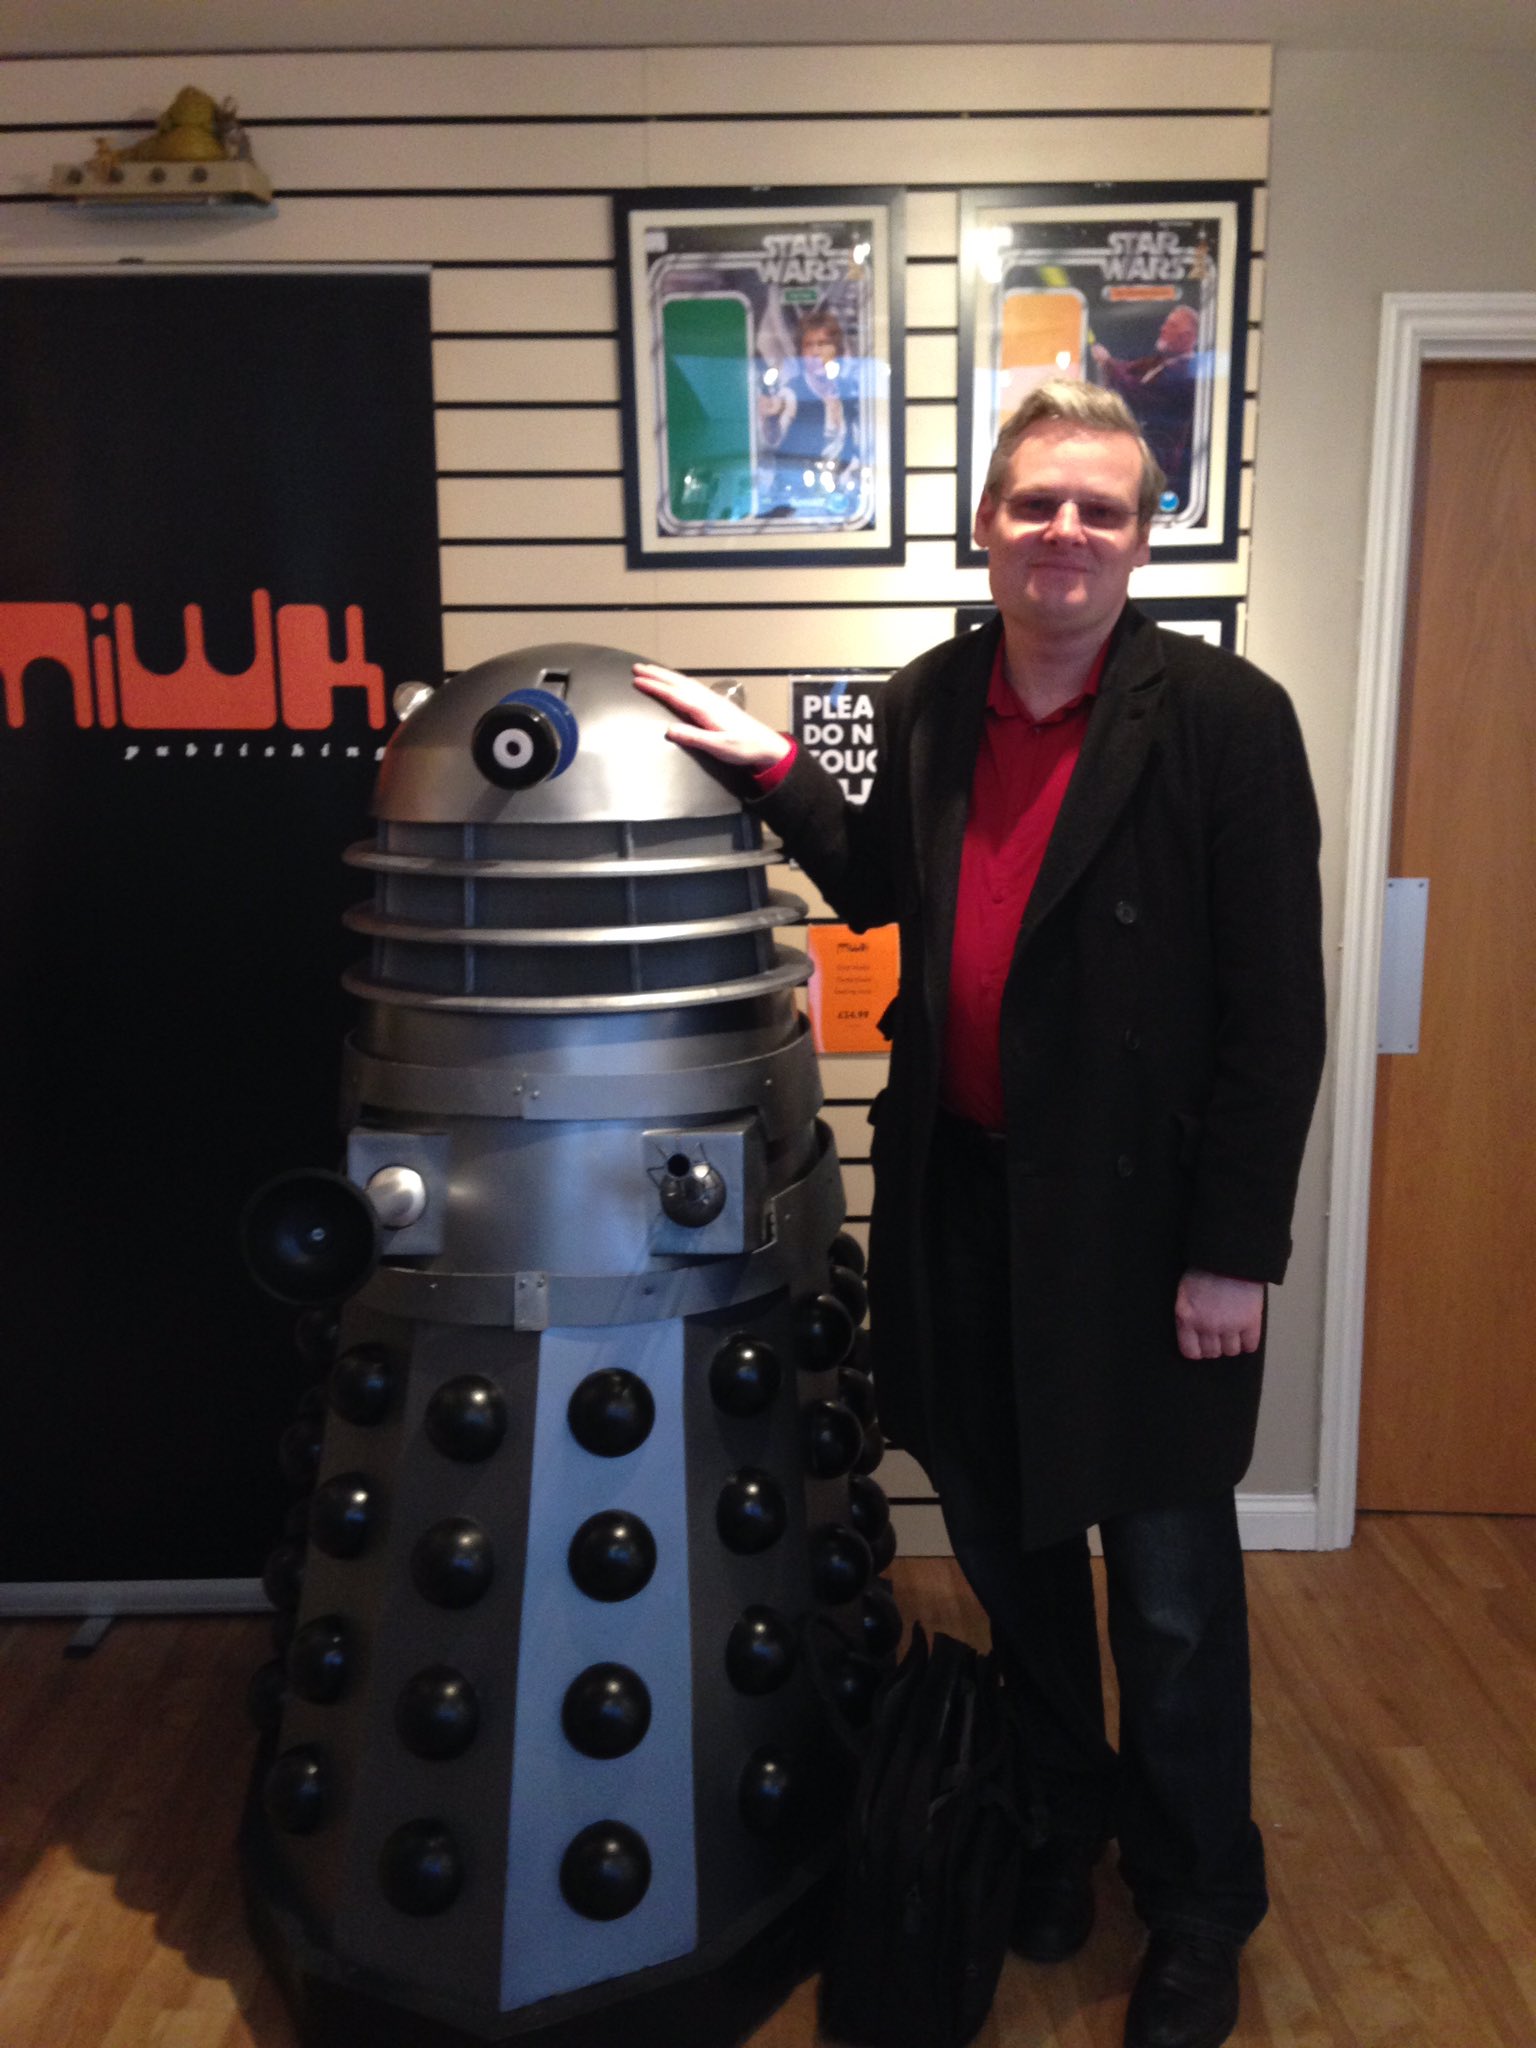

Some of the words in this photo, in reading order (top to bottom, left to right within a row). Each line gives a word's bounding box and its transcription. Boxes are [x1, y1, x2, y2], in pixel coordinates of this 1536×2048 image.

[762, 233, 834, 257] STAR
[1107, 231, 1180, 255] STAR
[758, 257, 840, 283] WARS
[1101, 256, 1185, 280] WARS
[803, 694, 874, 719] PLEA
[803, 723, 844, 745] DO
